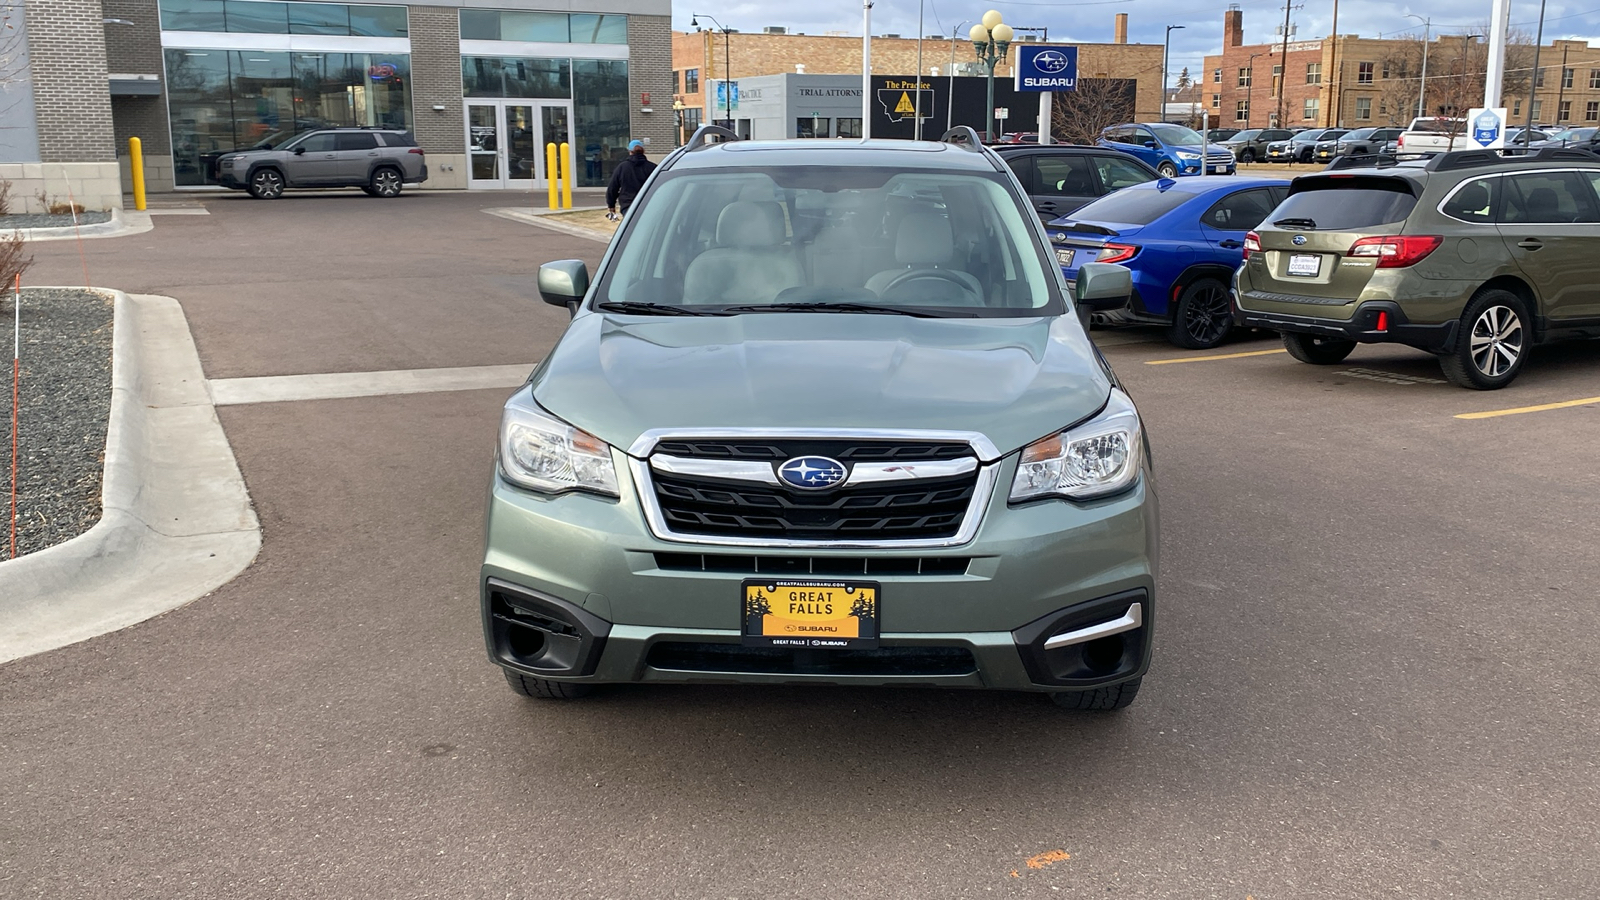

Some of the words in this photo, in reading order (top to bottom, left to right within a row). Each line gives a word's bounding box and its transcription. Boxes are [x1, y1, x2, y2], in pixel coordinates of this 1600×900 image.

[885, 80, 900, 89] The
[901, 80, 931, 90] Pracice
[1024, 78, 1073, 87] SUBARU
[789, 591, 833, 603] GREAT
[789, 603, 833, 615] FALLS
[798, 625, 838, 633] SUBARU
